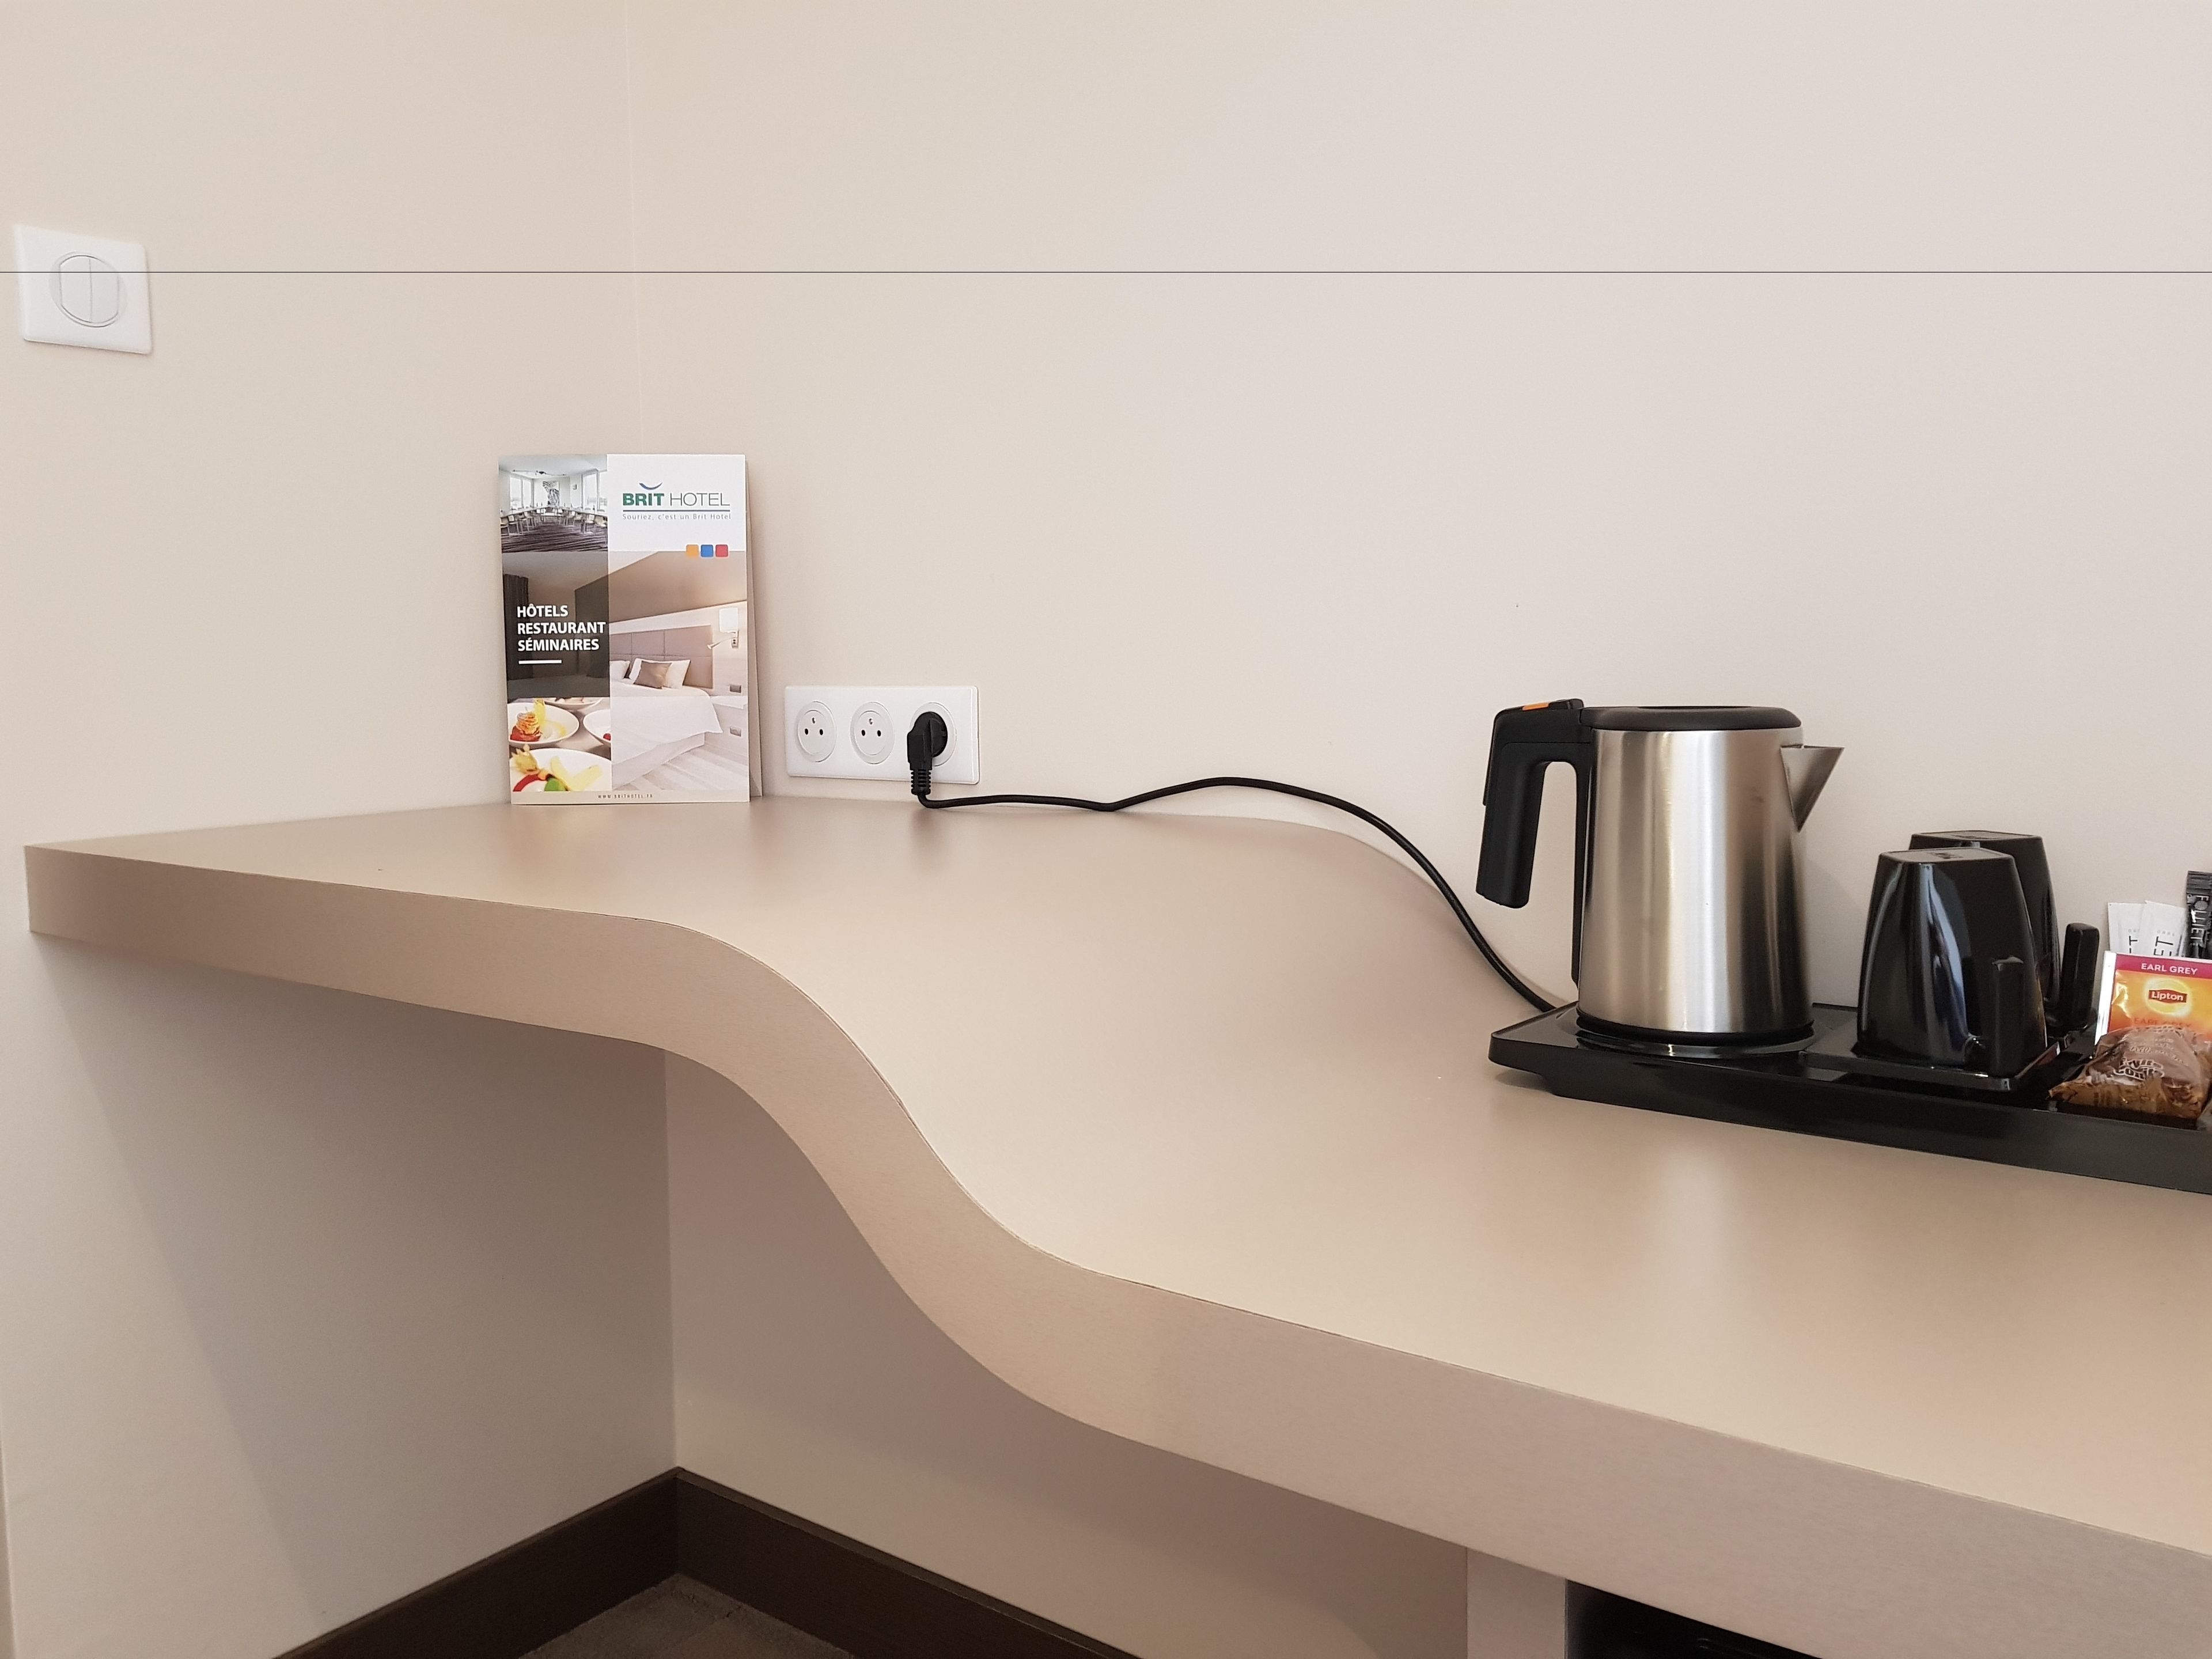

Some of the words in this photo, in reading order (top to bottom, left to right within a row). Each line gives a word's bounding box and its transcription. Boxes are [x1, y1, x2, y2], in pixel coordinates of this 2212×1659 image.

[622, 493, 664, 506] BRIT
[670, 493, 730, 506] HOTEL
[517, 603, 569, 618] HÔTELS
[517, 622, 606, 634] RESTAURANT
[518, 637, 600, 652] SÉMINAIRES
[2141, 963, 2167, 972] EARL
[2169, 967, 2198, 975] GREY
[2151, 991, 2184, 1001] Lipton
